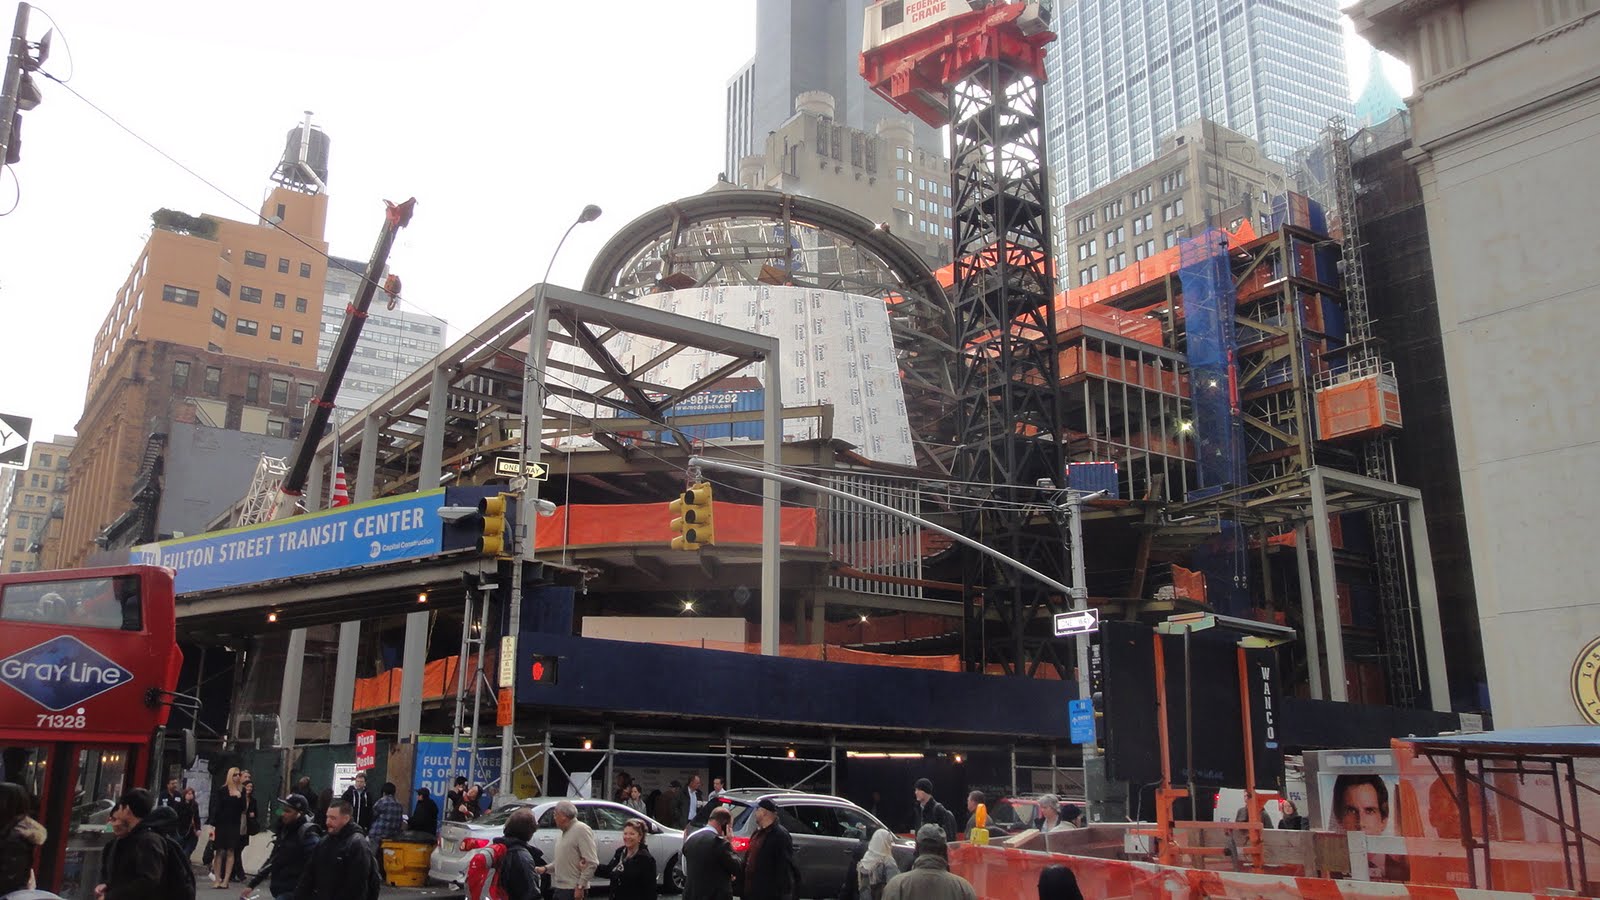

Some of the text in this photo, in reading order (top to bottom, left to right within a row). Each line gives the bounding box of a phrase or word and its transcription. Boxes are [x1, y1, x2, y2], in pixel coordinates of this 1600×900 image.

[912, 1, 946, 23] CRANE
[676, 394, 738, 405] 0-981-7292
[503, 463, 519, 472] ONE
[164, 546, 214, 570] FULTON
[219, 535, 275, 563] STREET
[279, 521, 348, 549] TRANSIT
[353, 507, 424, 538] CENTER
[401, 538, 434, 549] Construction
[1261, 667, 1275, 739] WANCO
[36, 714, 86, 729] 71328
[357, 756, 374, 768] Pasta
[1345, 754, 1376, 765] TITAN
[423, 768, 433, 778] IS
